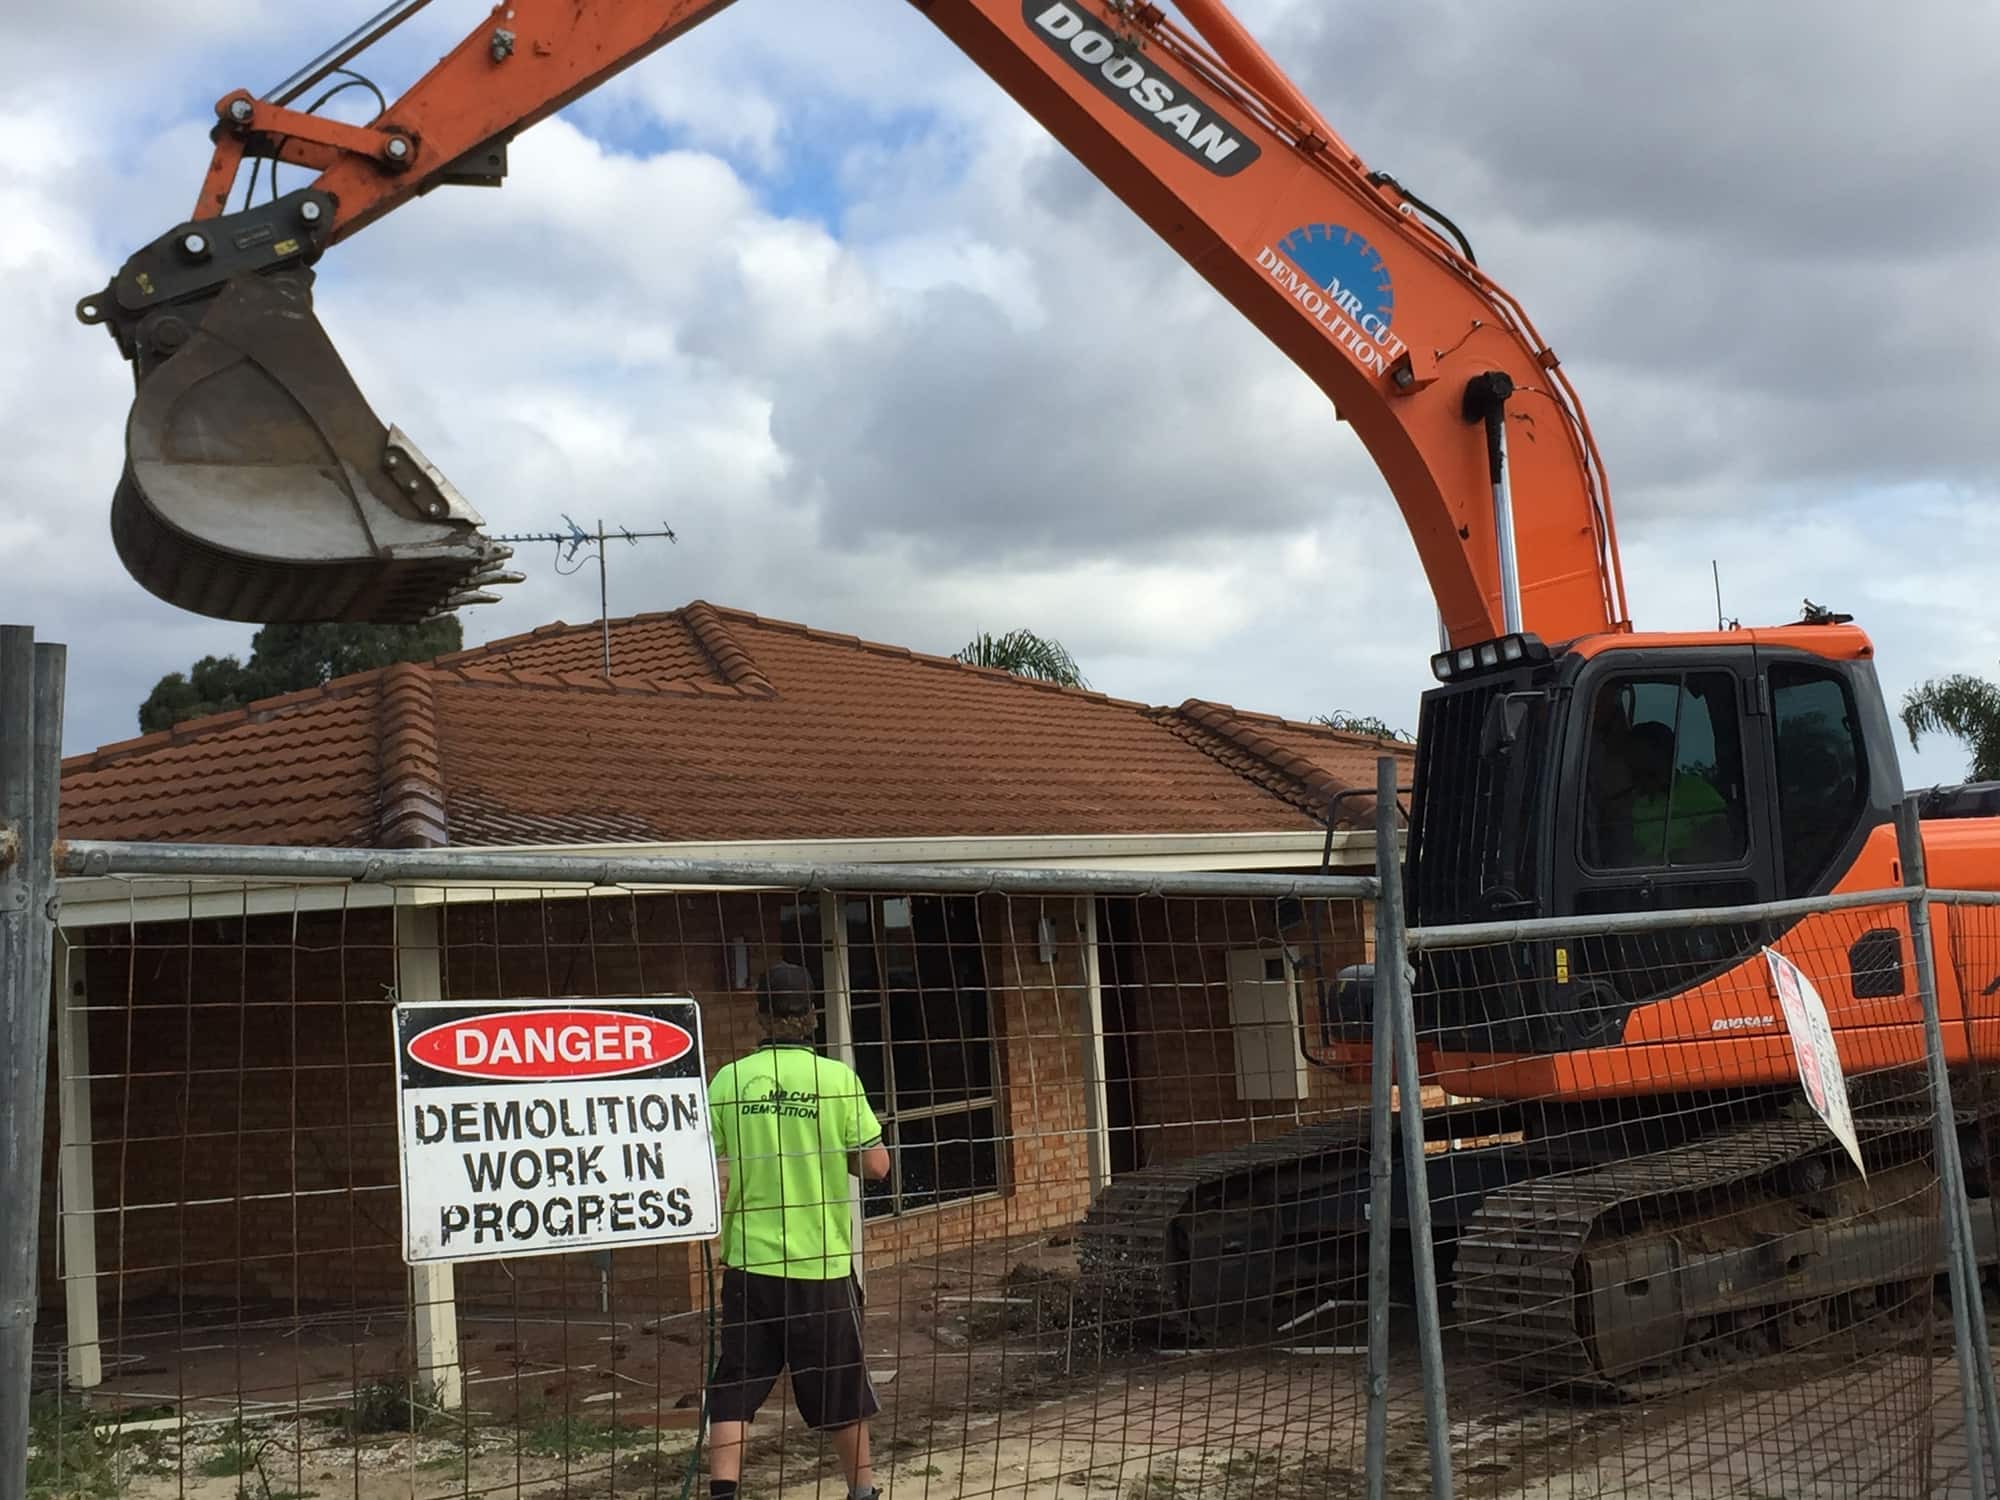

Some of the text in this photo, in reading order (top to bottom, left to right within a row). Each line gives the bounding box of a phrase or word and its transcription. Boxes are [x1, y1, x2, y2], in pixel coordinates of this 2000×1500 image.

[1035, 3, 1240, 164] DOOSAN
[1255, 246, 1391, 377] DEMOLITION
[1323, 277, 1408, 359] MR CUT
[455, 1025, 654, 1066] DANGER
[414, 1093, 699, 1145] DEMOLITION
[741, 1104, 819, 1119] DEMOLITION
[790, 1091, 818, 1104] CUT
[463, 1142, 665, 1193] WORK IN
[441, 1187, 694, 1247] PROGRESS
